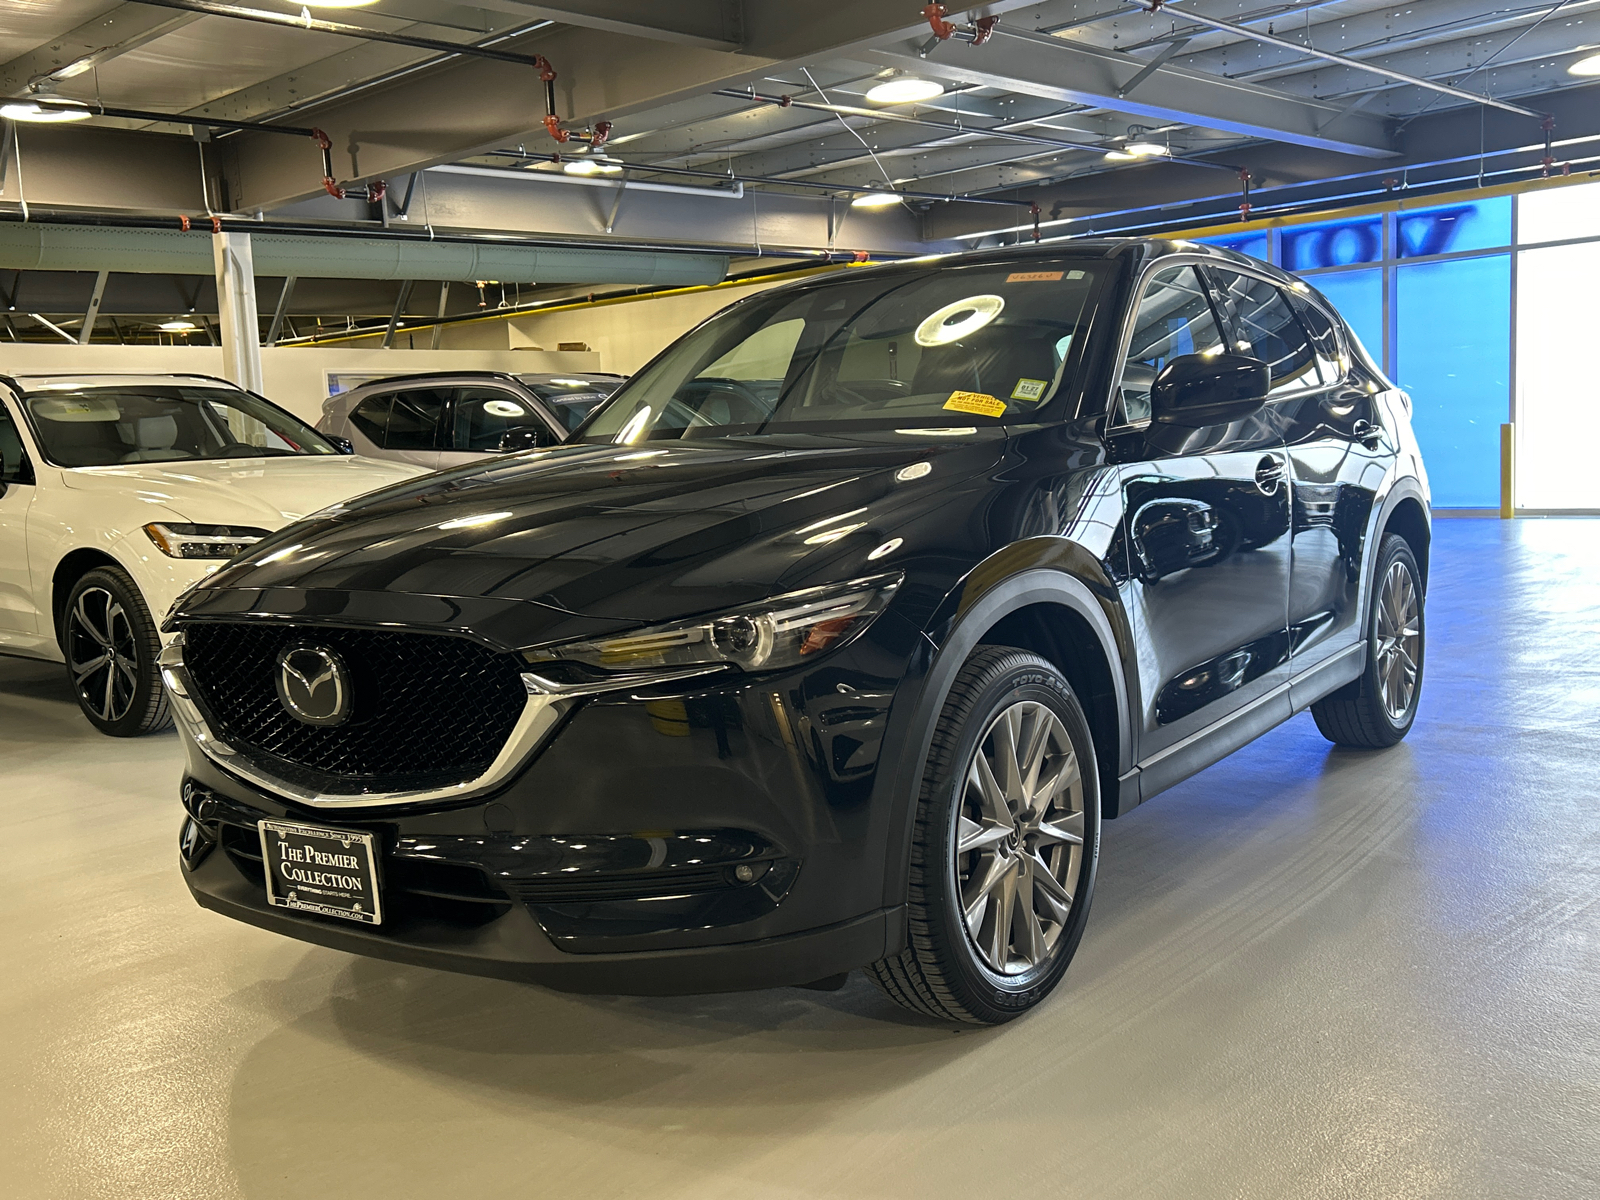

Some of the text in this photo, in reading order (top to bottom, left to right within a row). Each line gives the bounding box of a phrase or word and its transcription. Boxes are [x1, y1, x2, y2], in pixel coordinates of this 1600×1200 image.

[1012, 674, 1043, 687] TOYO
[278, 841, 359, 869] THE PREMIER
[281, 862, 362, 890] COLLECTION
[994, 987, 1041, 1006] TOYO
